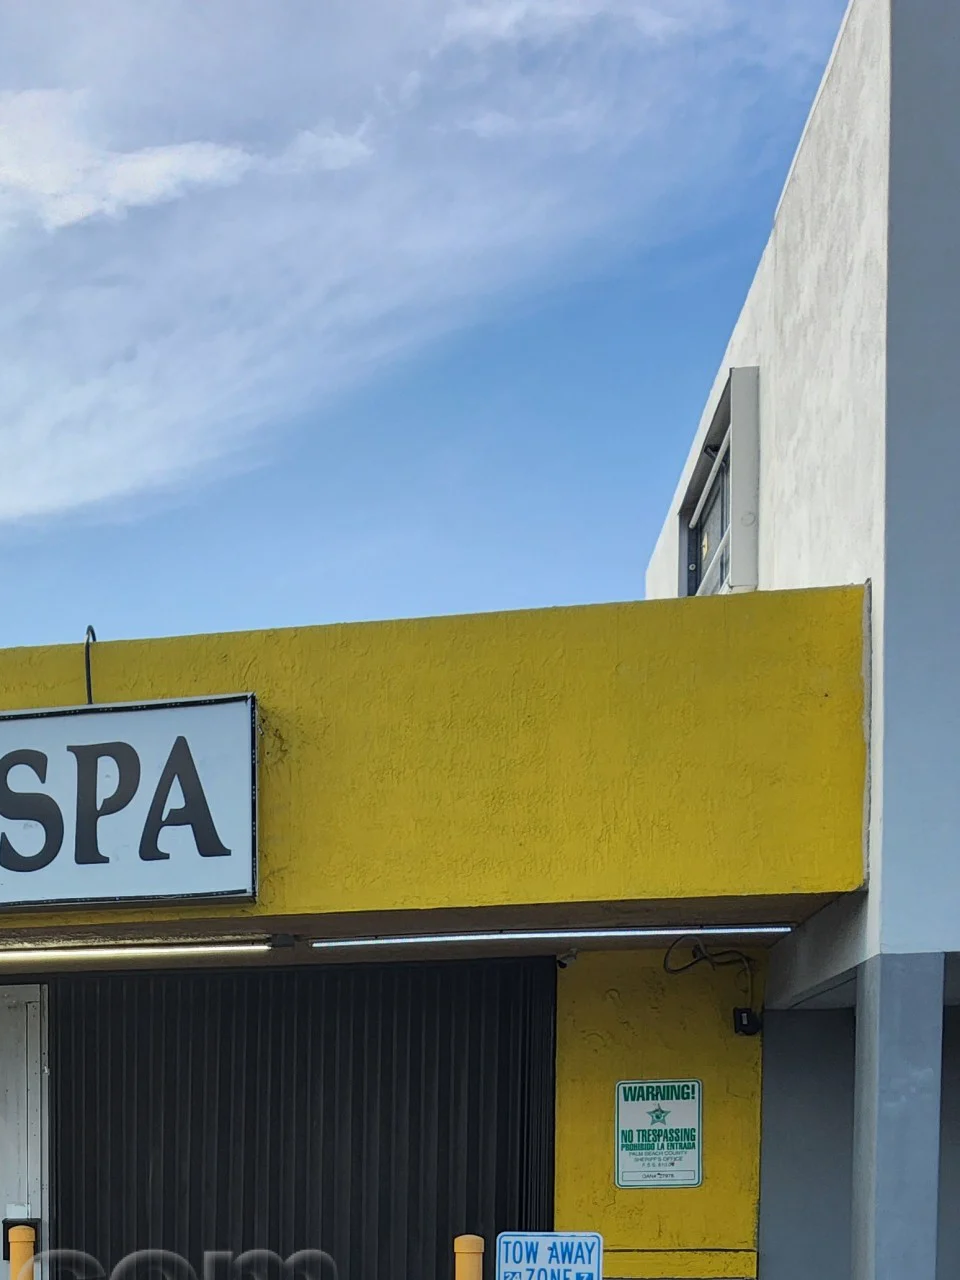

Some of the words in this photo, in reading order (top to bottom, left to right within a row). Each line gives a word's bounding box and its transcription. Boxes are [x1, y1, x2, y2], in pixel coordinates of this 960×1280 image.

[622, 1084, 696, 1102] WARNING!
[621, 1129, 634, 1143] NO
[636, 1128, 696, 1142] TRESPASSING
[621, 1143, 655, 1151] PROHIBIDO
[657, 1142, 665, 1151] LA
[666, 1142, 696, 1150] ENTRADA
[503, 1240, 539, 1264] TOW
[547, 1240, 596, 1265] AWAY
